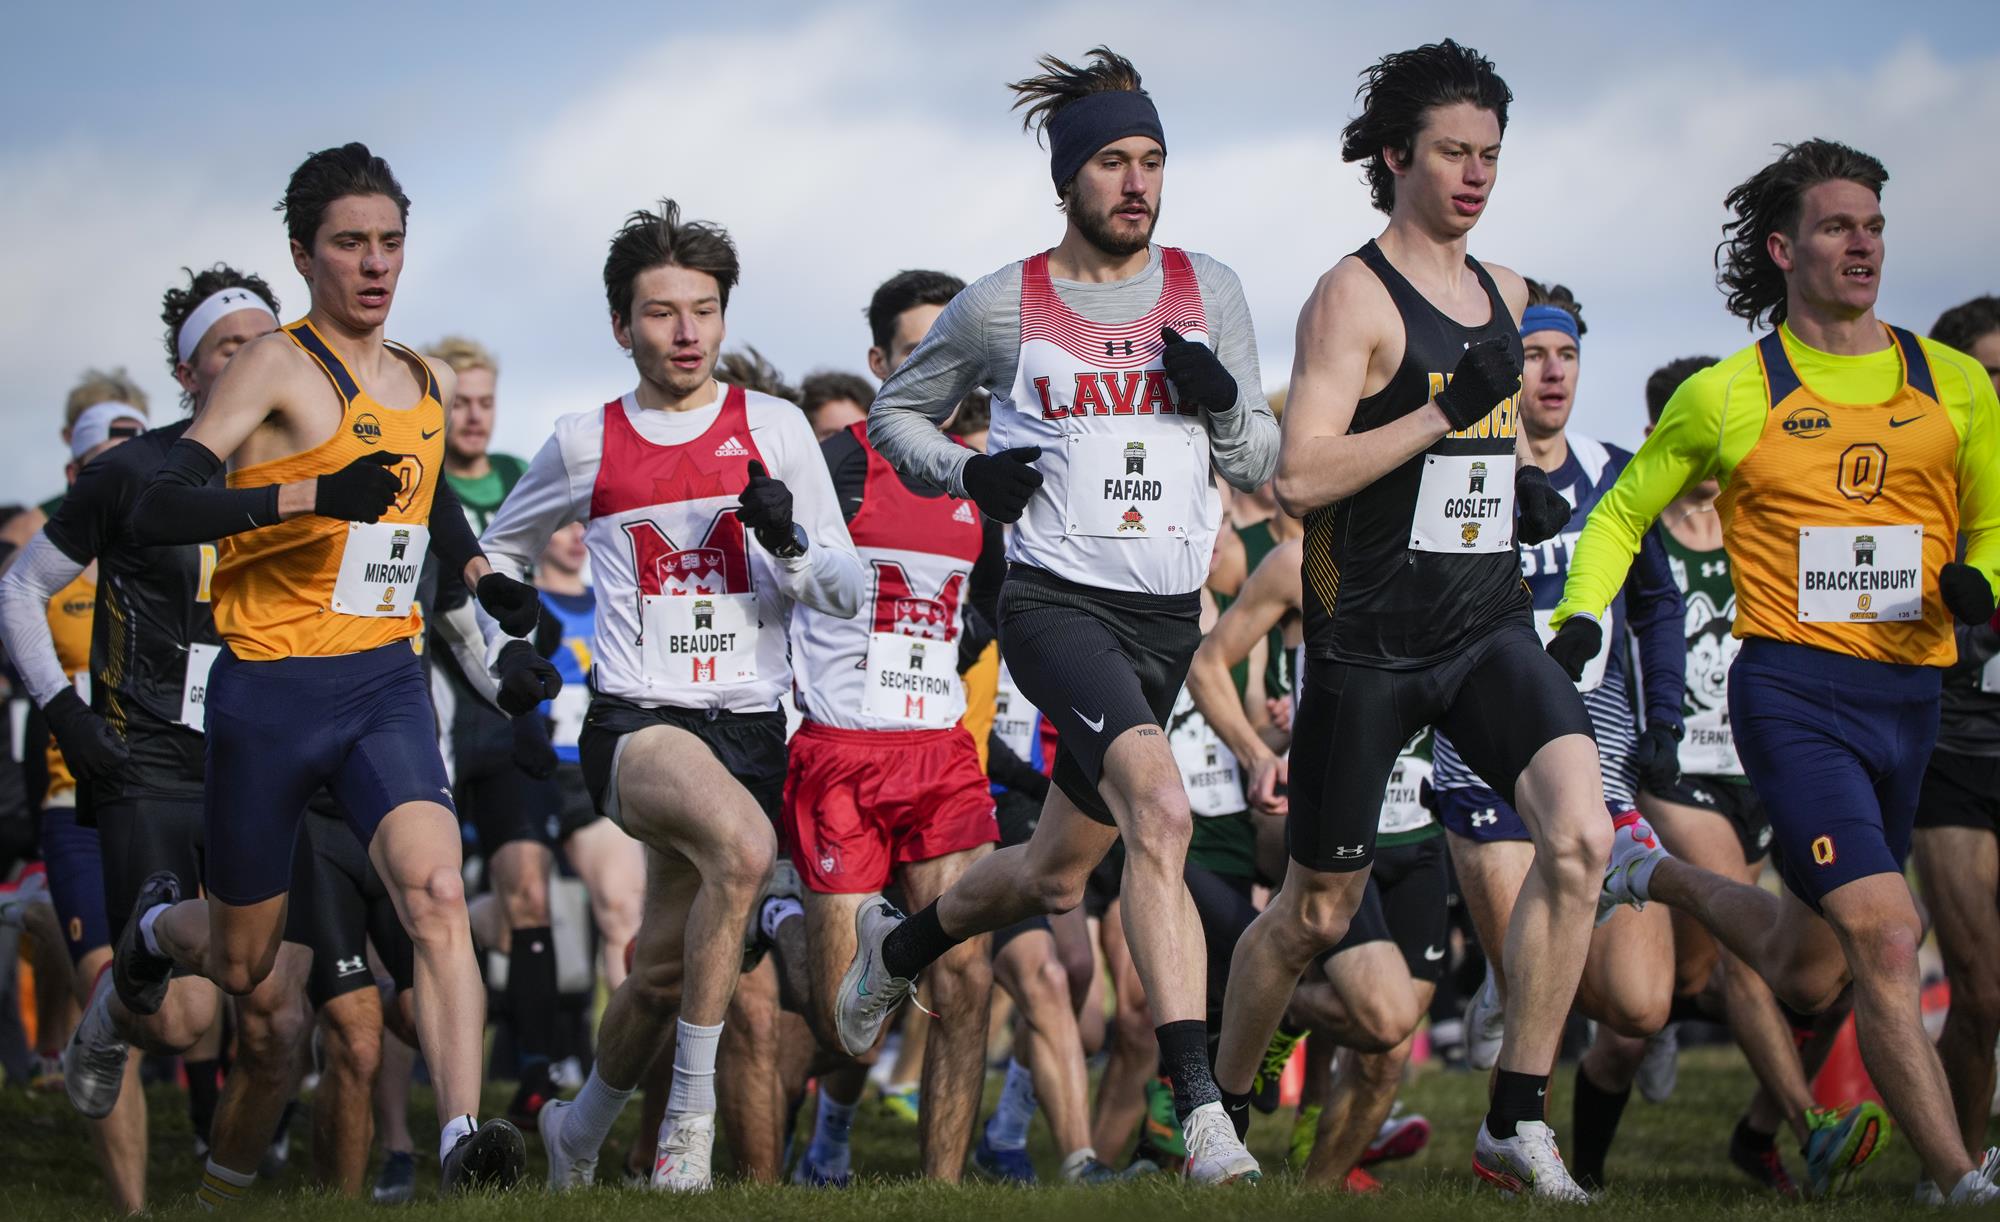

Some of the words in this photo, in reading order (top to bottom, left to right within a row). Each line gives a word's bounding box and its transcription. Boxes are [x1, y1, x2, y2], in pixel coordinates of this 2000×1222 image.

[352, 423, 382, 437] OUA
[1782, 417, 1832, 431] OUA
[714, 449, 749, 457] adidas
[1836, 442, 1888, 505] Q
[1104, 478, 1162, 501] FAFARD
[1444, 497, 1502, 519] GOSLETT
[364, 562, 418, 584] MIRONOV
[1805, 568, 1918, 591] BRACKENBURY
[669, 632, 737, 654] BEAUDET
[880, 669, 950, 696] SECHEYRON
[1189, 768, 1233, 788] WEBSTER
